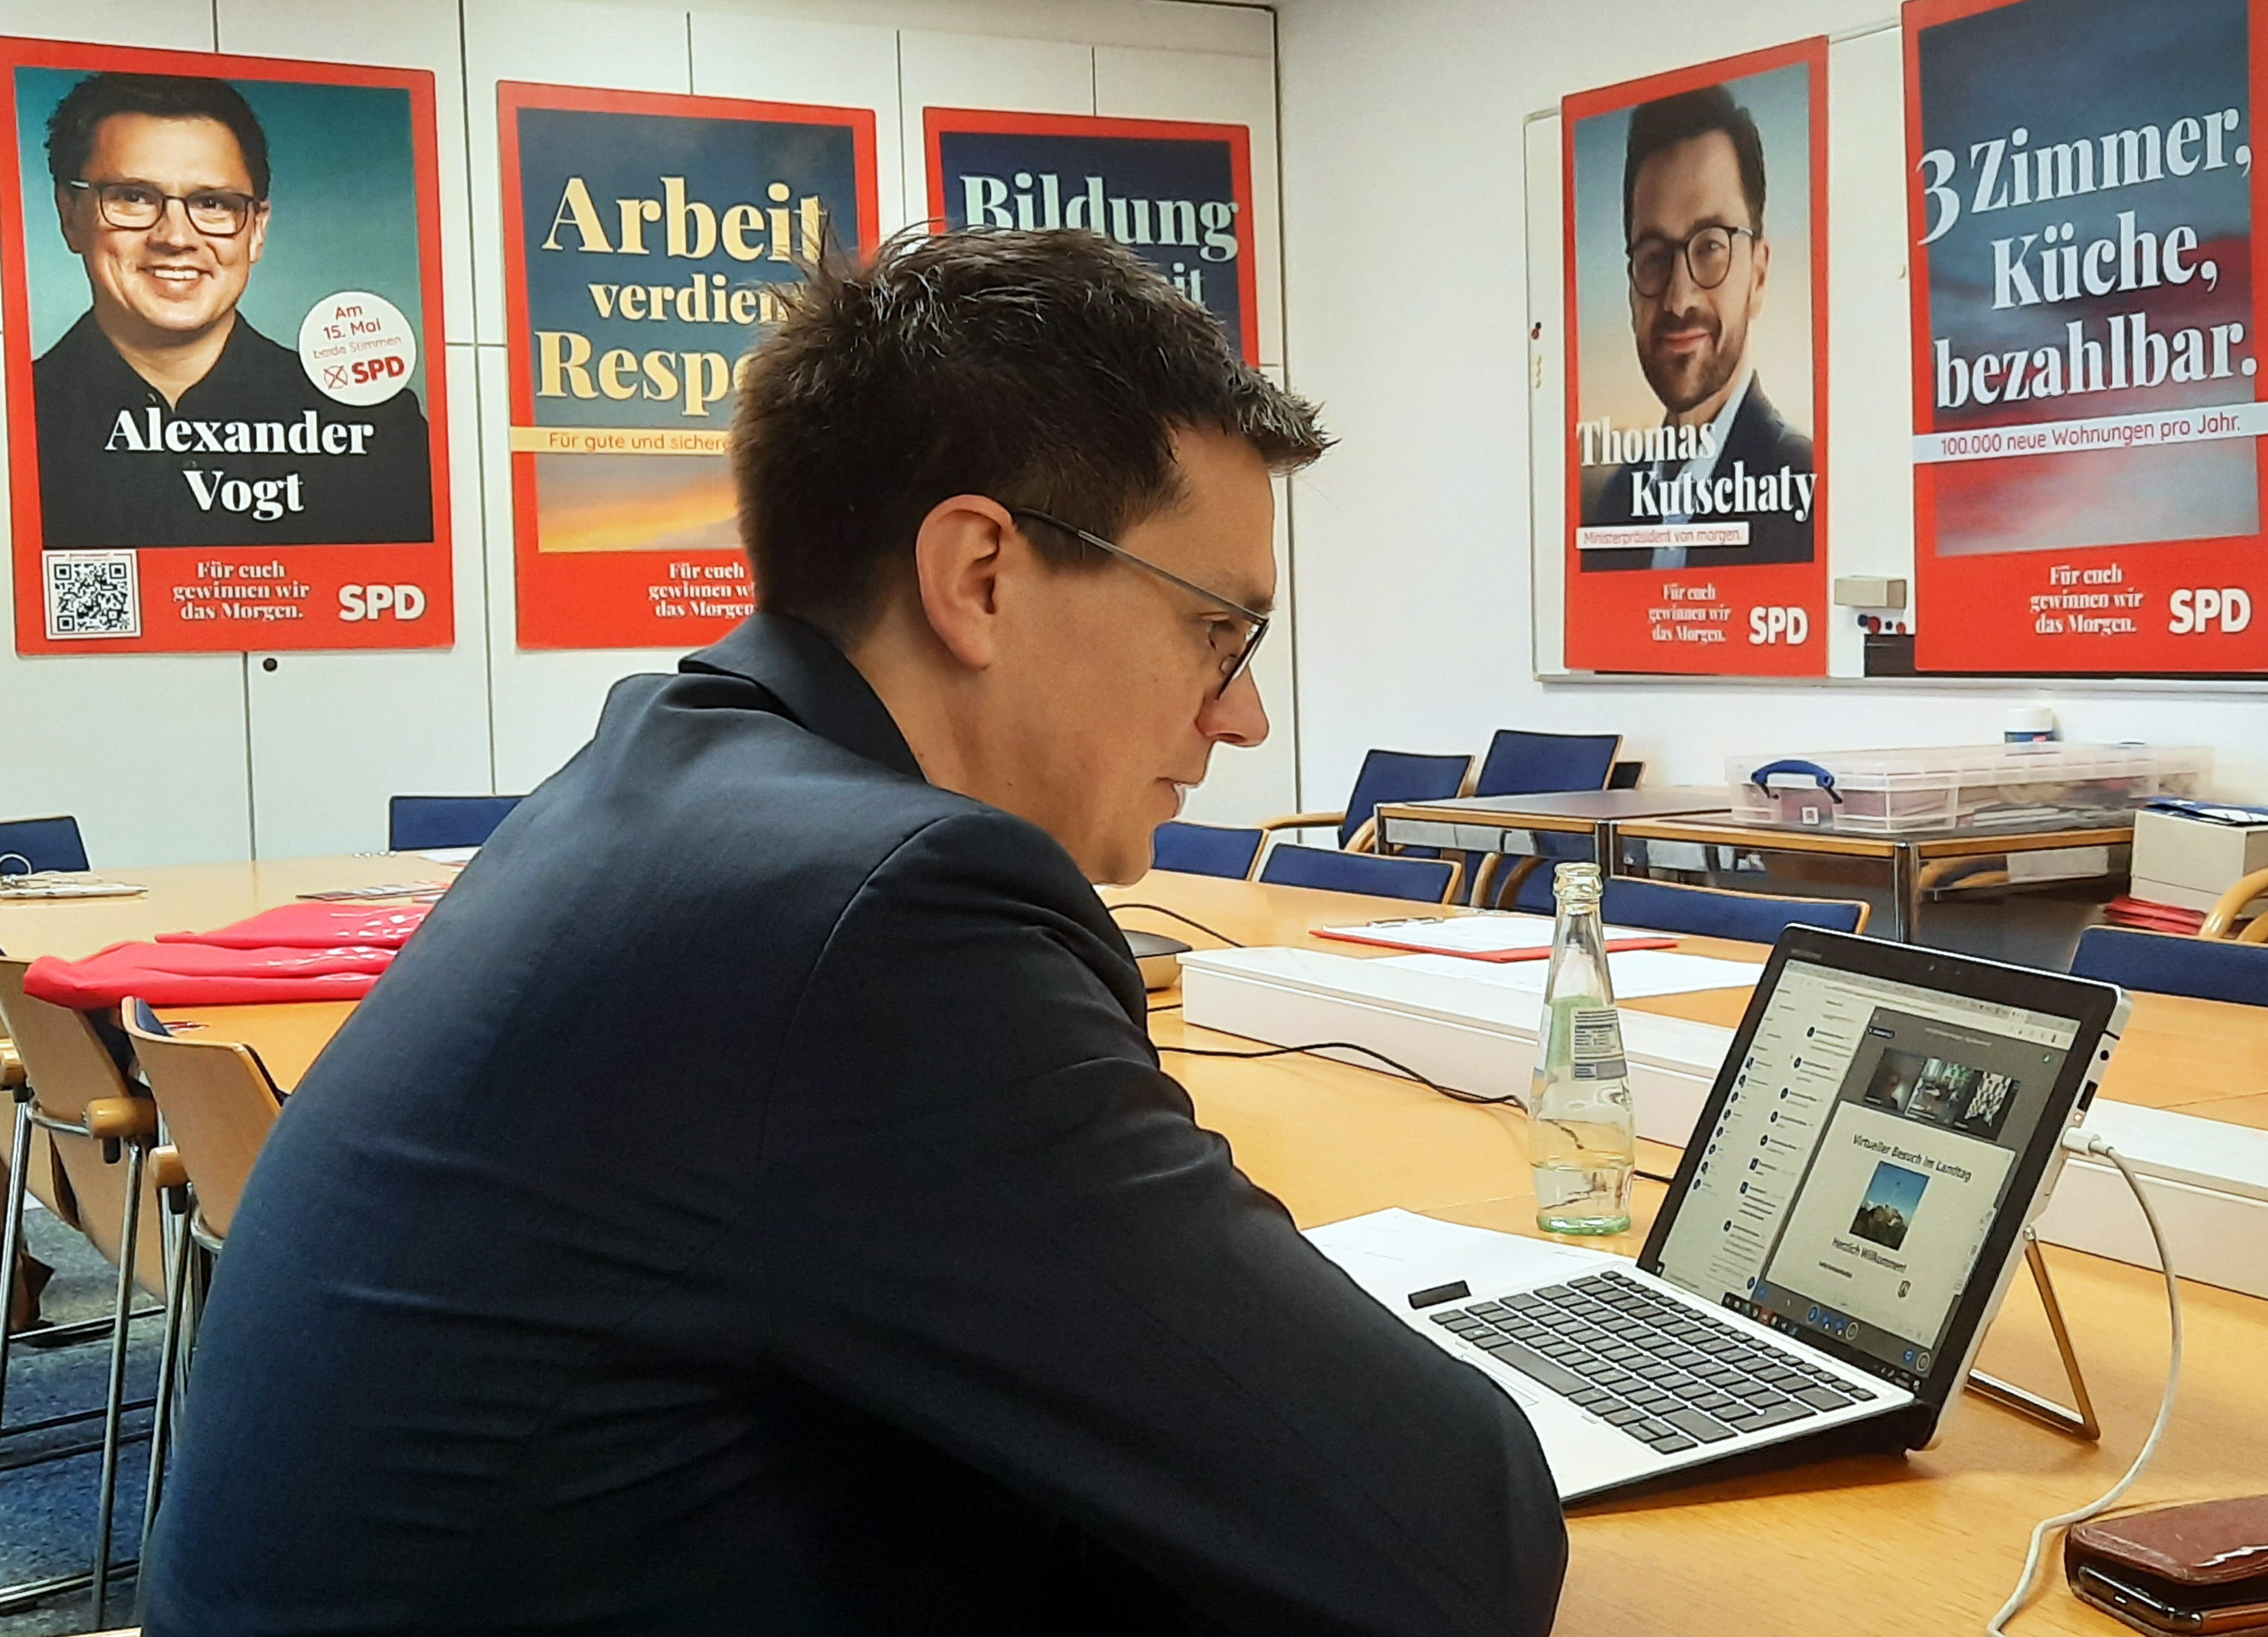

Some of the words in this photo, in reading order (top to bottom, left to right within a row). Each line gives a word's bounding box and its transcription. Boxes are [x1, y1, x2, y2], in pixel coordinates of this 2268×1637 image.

[1916, 148, 1961, 246] 3
[1970, 108, 2252, 214] Zimmer,
[541, 176, 827, 264] Arbeit
[959, 169, 1239, 263] Bildung
[1990, 209, 2219, 311] Küche,
[588, 273, 800, 325] verdien
[335, 305, 363, 320] Am
[323, 325, 346, 340] 15.
[349, 317, 382, 336] Mai
[349, 337, 402, 353] Stimmen
[351, 355, 405, 384] SPD
[1934, 311, 2257, 409] bezahlbar.
[105, 407, 374, 455] Alexander
[549, 431, 579, 449] Für
[584, 434, 626, 453] gute
[631, 434, 665, 450] und
[1576, 416, 1717, 466] Thomas
[1940, 433, 2002, 456] 100.000
[2007, 431, 2047, 451] neue
[2051, 422, 2154, 447] Wohnungen
[2160, 418, 2190, 442] pro
[2197, 412, 2241, 434] Jahr.
[182, 469, 305, 521] Vogt
[1630, 460, 1818, 522] Kutschaty
[1674, 530, 1693, 543] von
[197, 561, 235, 579] Für
[238, 560, 285, 579] euch
[669, 562, 701, 579] Für
[704, 562, 745, 579] euch
[2050, 565, 2080, 586] Für
[2083, 563, 2123, 585] euch
[172, 581, 270, 602] gewinnen
[275, 580, 311, 599] wir
[338, 584, 426, 621] SPD
[648, 581, 732, 601] gewinnen
[1662, 583, 1686, 600] Für
[1687, 583, 1716, 600] euch
[2029, 588, 2109, 613] gewinnen
[2113, 587, 2144, 608] wir
[180, 602, 217, 620] das
[221, 602, 304, 623] Morgen.
[654, 600, 686, 617] das
[1648, 603, 1707, 624] gewinnen
[1709, 603, 1731, 621] wir
[2168, 587, 2251, 634] SPD
[1651, 625, 1672, 642] das
[1675, 625, 1727, 645] Morgen.
[1748, 606, 1809, 645] SPD
[2035, 614, 2064, 635] das
[2068, 614, 2137, 637] Morgen.
